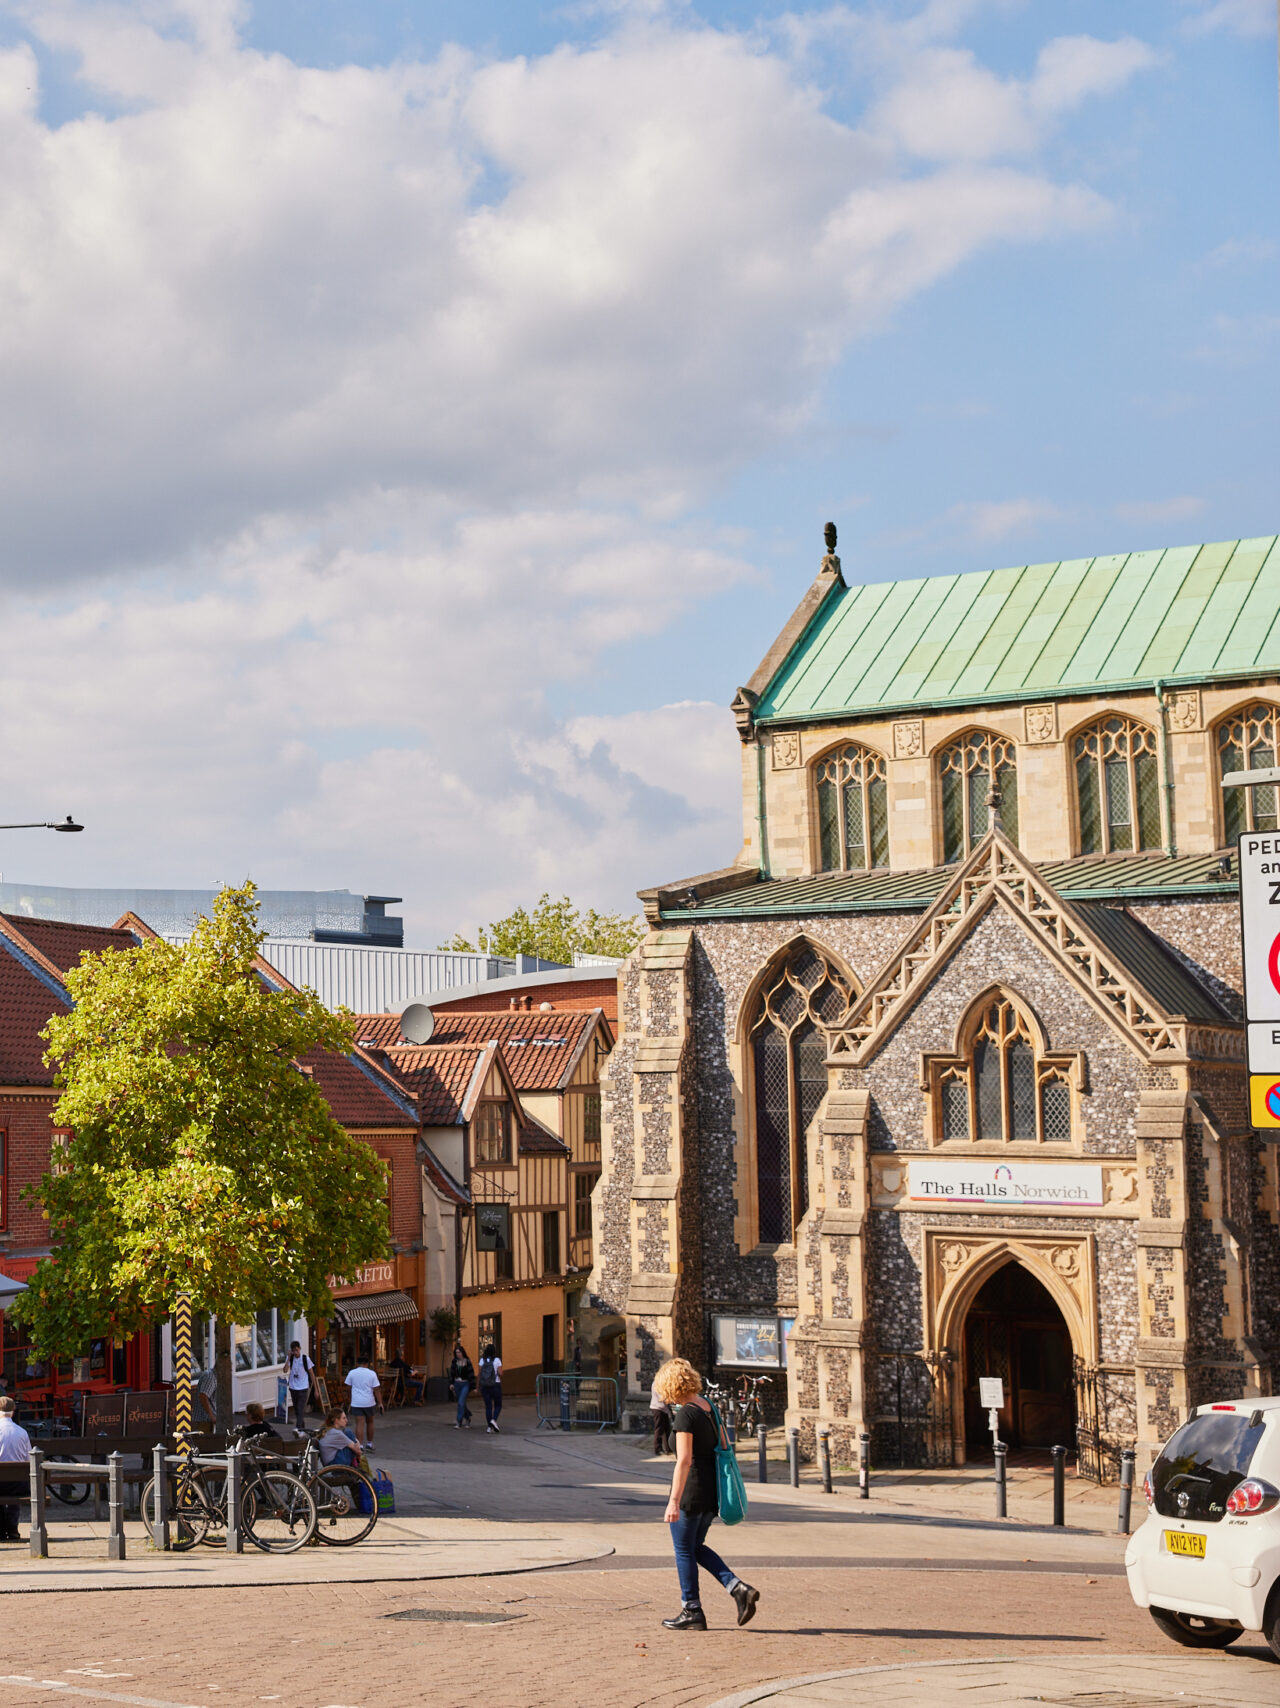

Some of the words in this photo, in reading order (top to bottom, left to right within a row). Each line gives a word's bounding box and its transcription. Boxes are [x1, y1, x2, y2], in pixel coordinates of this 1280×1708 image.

[922, 1181, 954, 1195] The
[960, 1183, 1007, 1196] Halls
[1013, 1184, 1088, 1199] Norwich
[328, 1266, 392, 1288] AMRETTO
[1170, 1533, 1187, 1550] AV12
[1187, 1536, 1204, 1553] YFA
